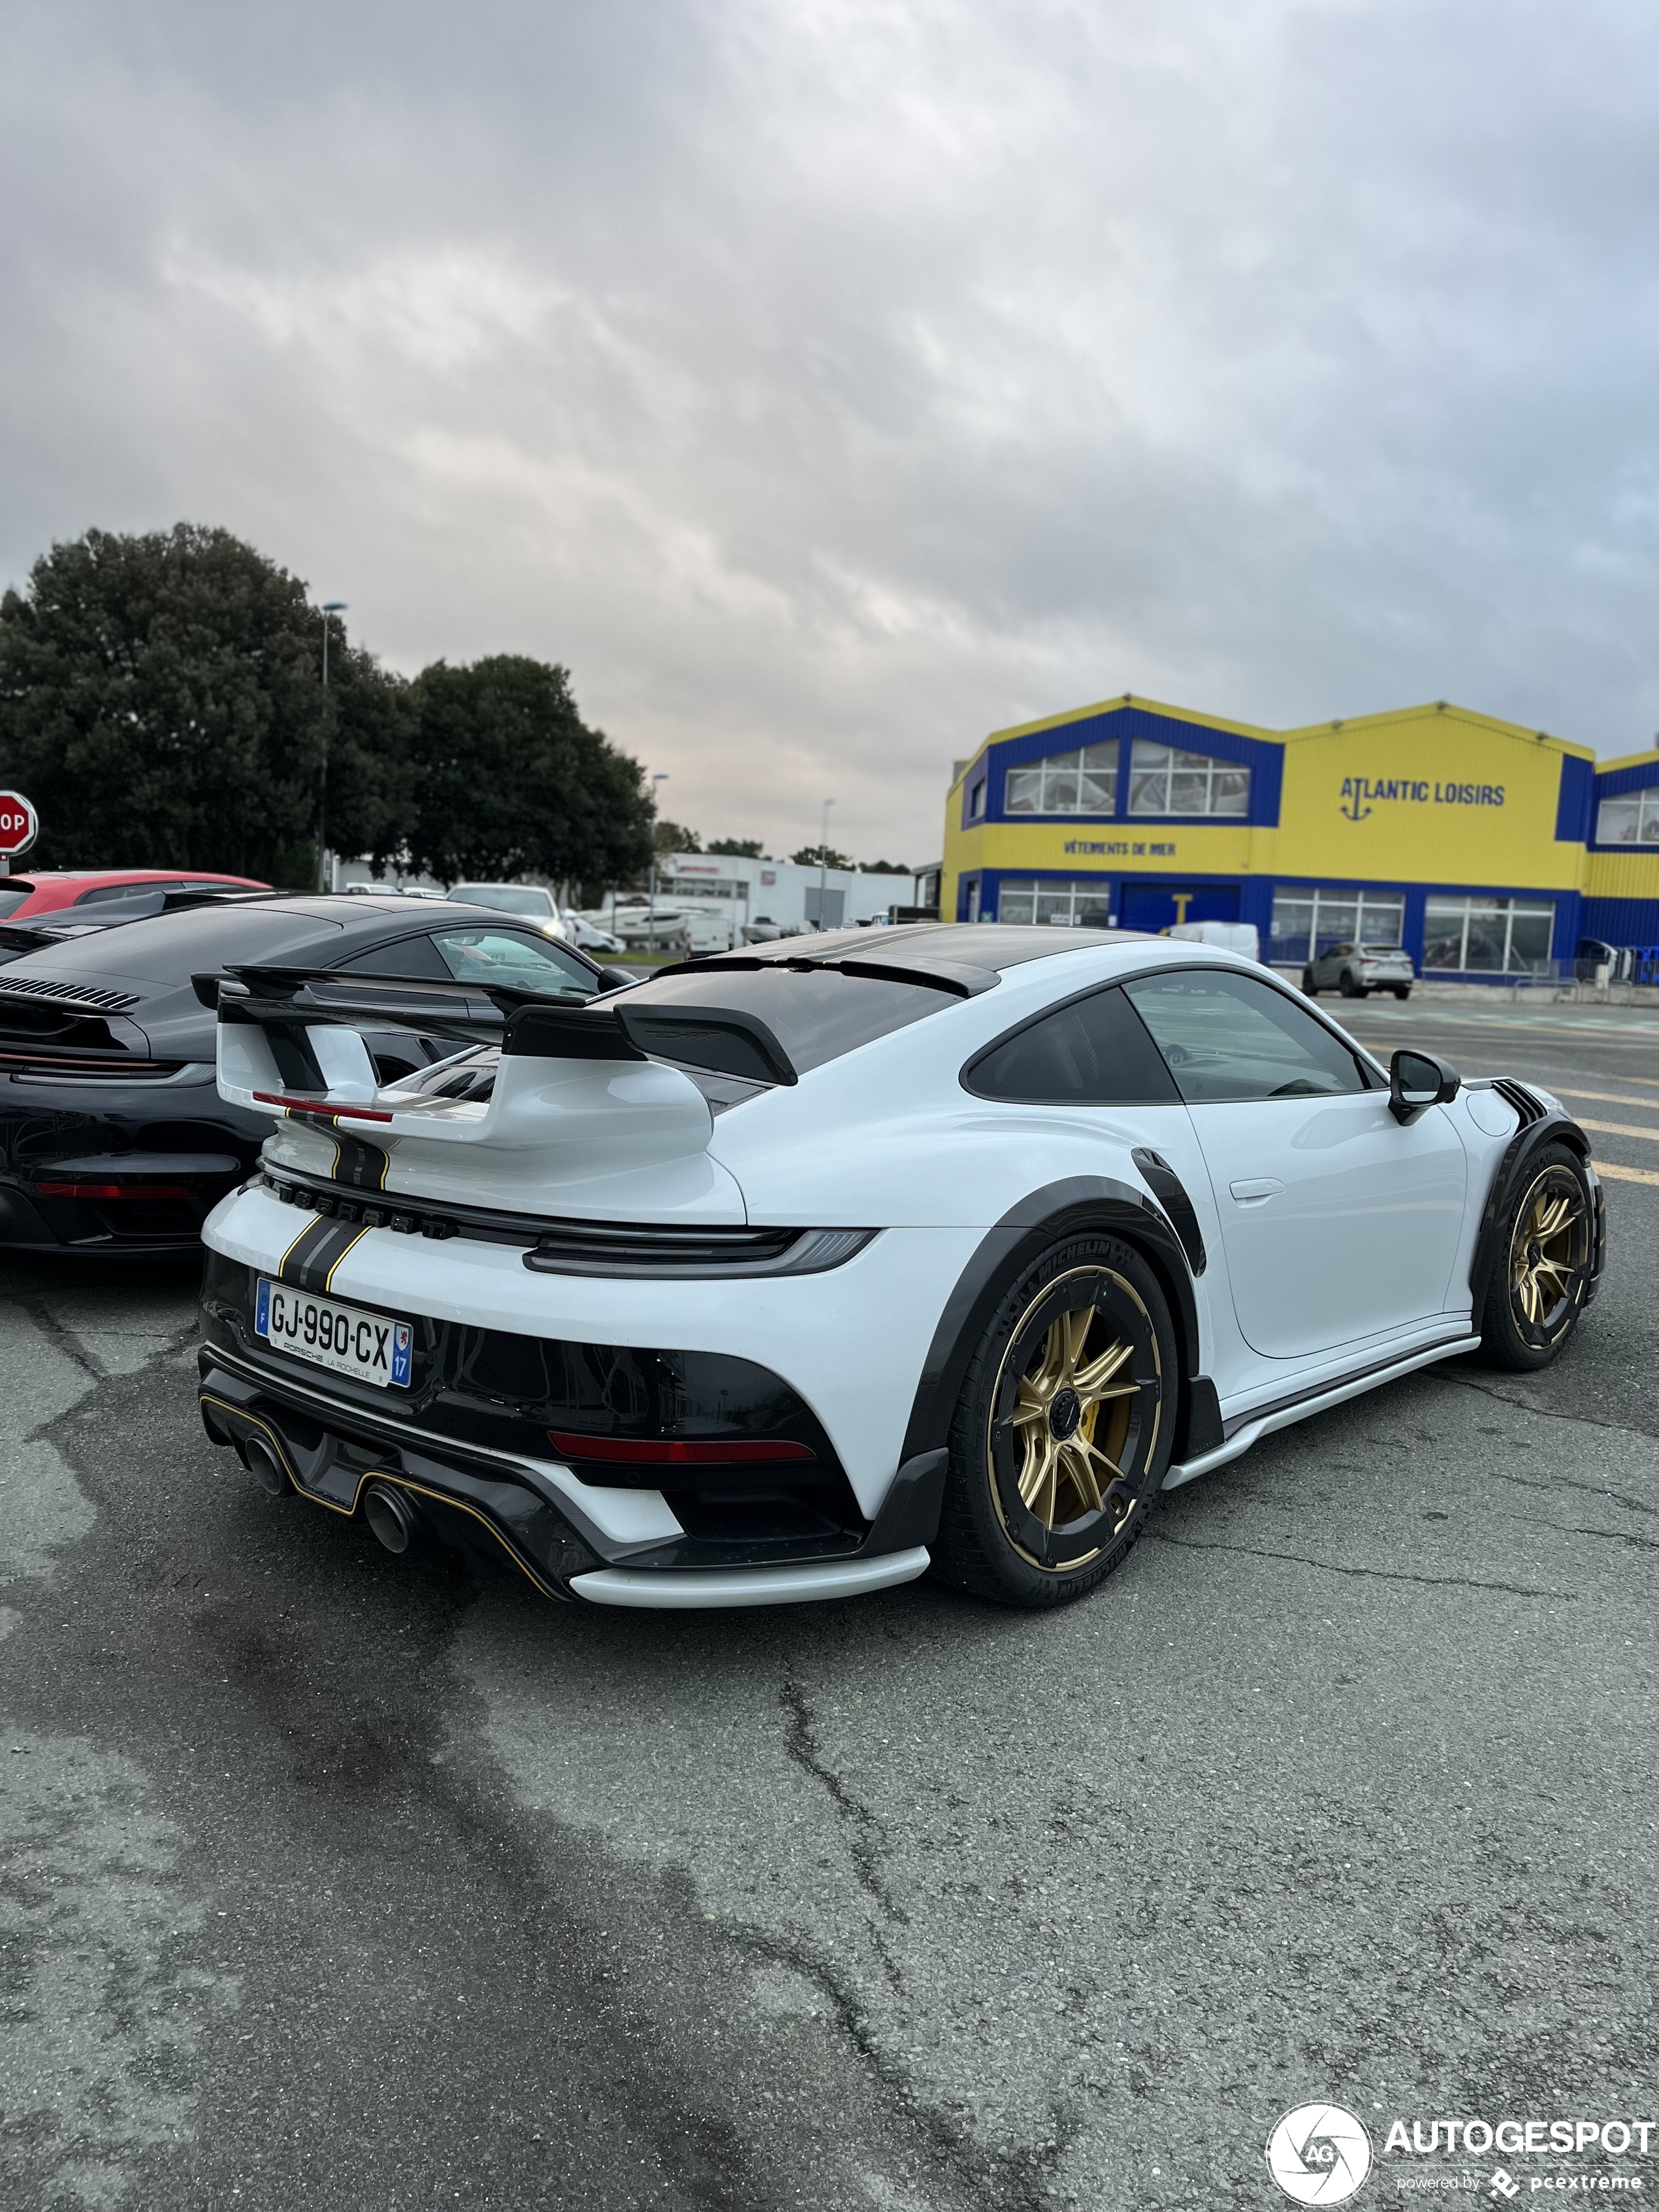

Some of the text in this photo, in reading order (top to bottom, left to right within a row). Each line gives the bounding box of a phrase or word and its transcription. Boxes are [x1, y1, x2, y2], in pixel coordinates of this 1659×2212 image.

[1340, 777, 1505, 820] ATLANTIC LOISIRS
[0, 814, 25, 831] OP
[1132, 842, 1146, 856] DE
[1150, 843, 1175, 856] MER
[645, 1030, 720, 1040] TECHART
[279, 1185, 448, 1240] TECHART
[1039, 1240, 1110, 1281] MICHELIN
[261, 1312, 265, 1324] F
[272, 1293, 389, 1370] GJ-990-CX
[283, 1342, 370, 1379] PORSCHE LA ROCHELLE
[395, 1356, 407, 1377] 17
[1059, 1542, 1127, 1597] MICHELIN
